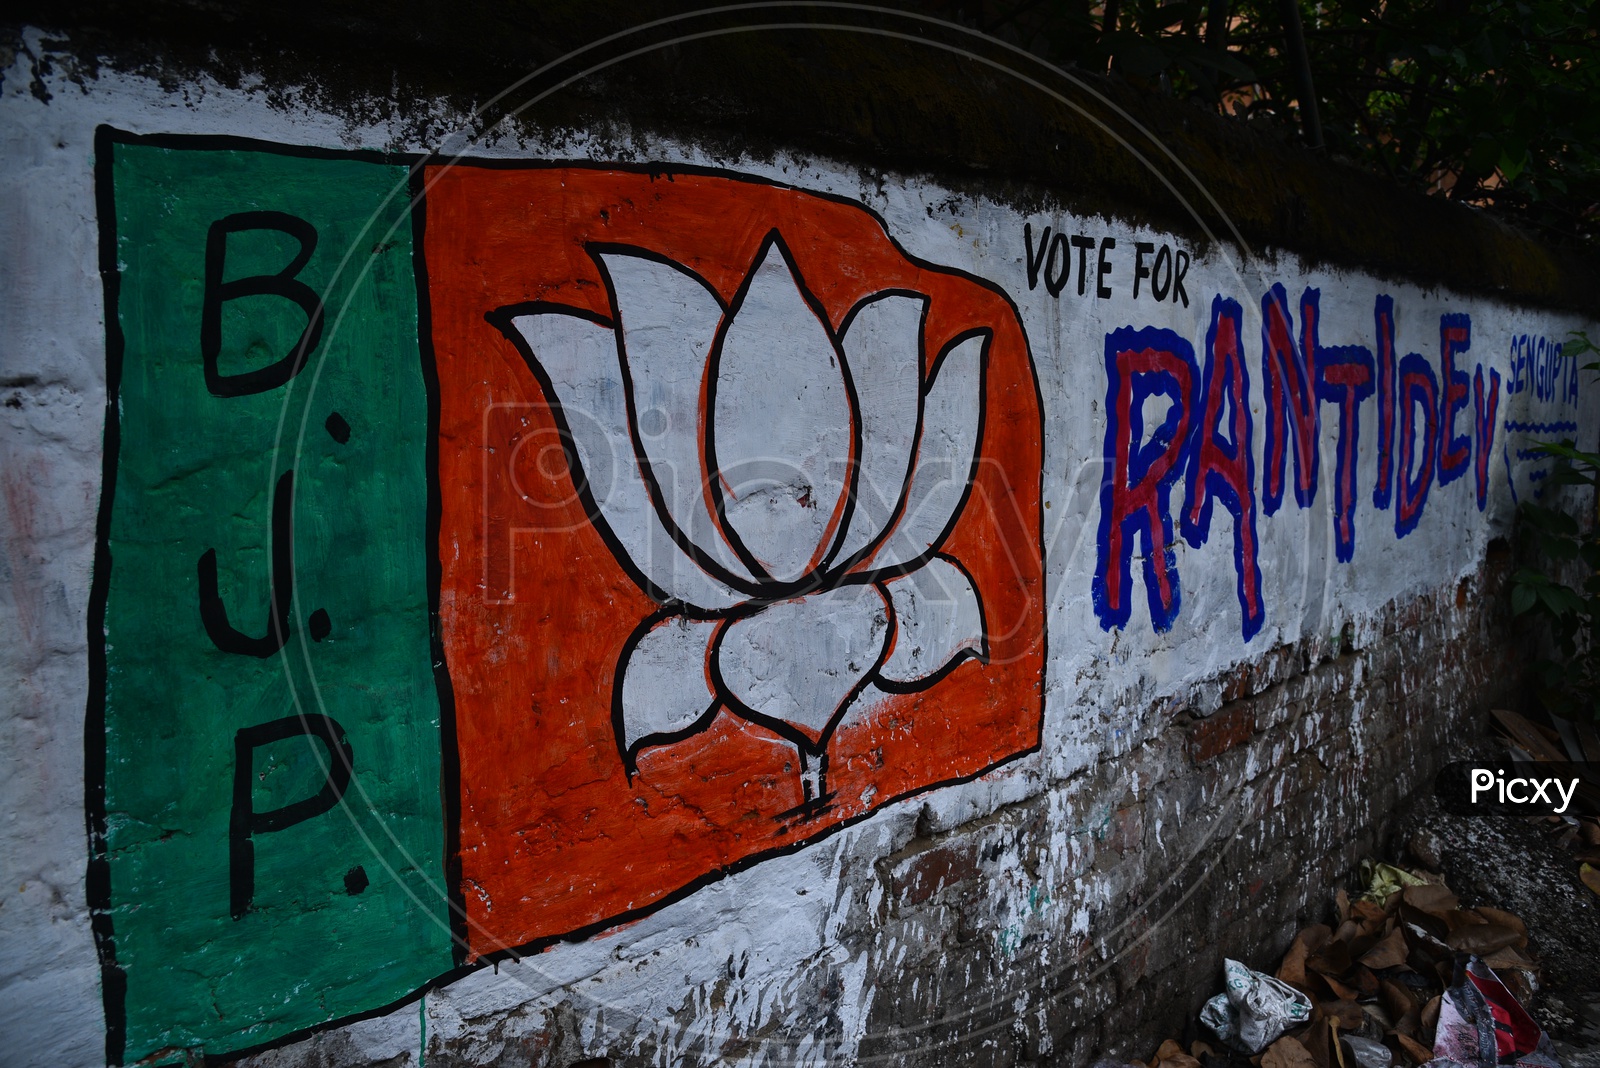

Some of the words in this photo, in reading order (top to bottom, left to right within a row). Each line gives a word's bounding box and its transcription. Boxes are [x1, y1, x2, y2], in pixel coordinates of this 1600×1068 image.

[1024, 223, 1116, 299] VOTE
[1133, 241, 1190, 308] FOR
[1506, 333, 1578, 410] SENGUPTA
[1091, 281, 1500, 643] RANTIDEV
